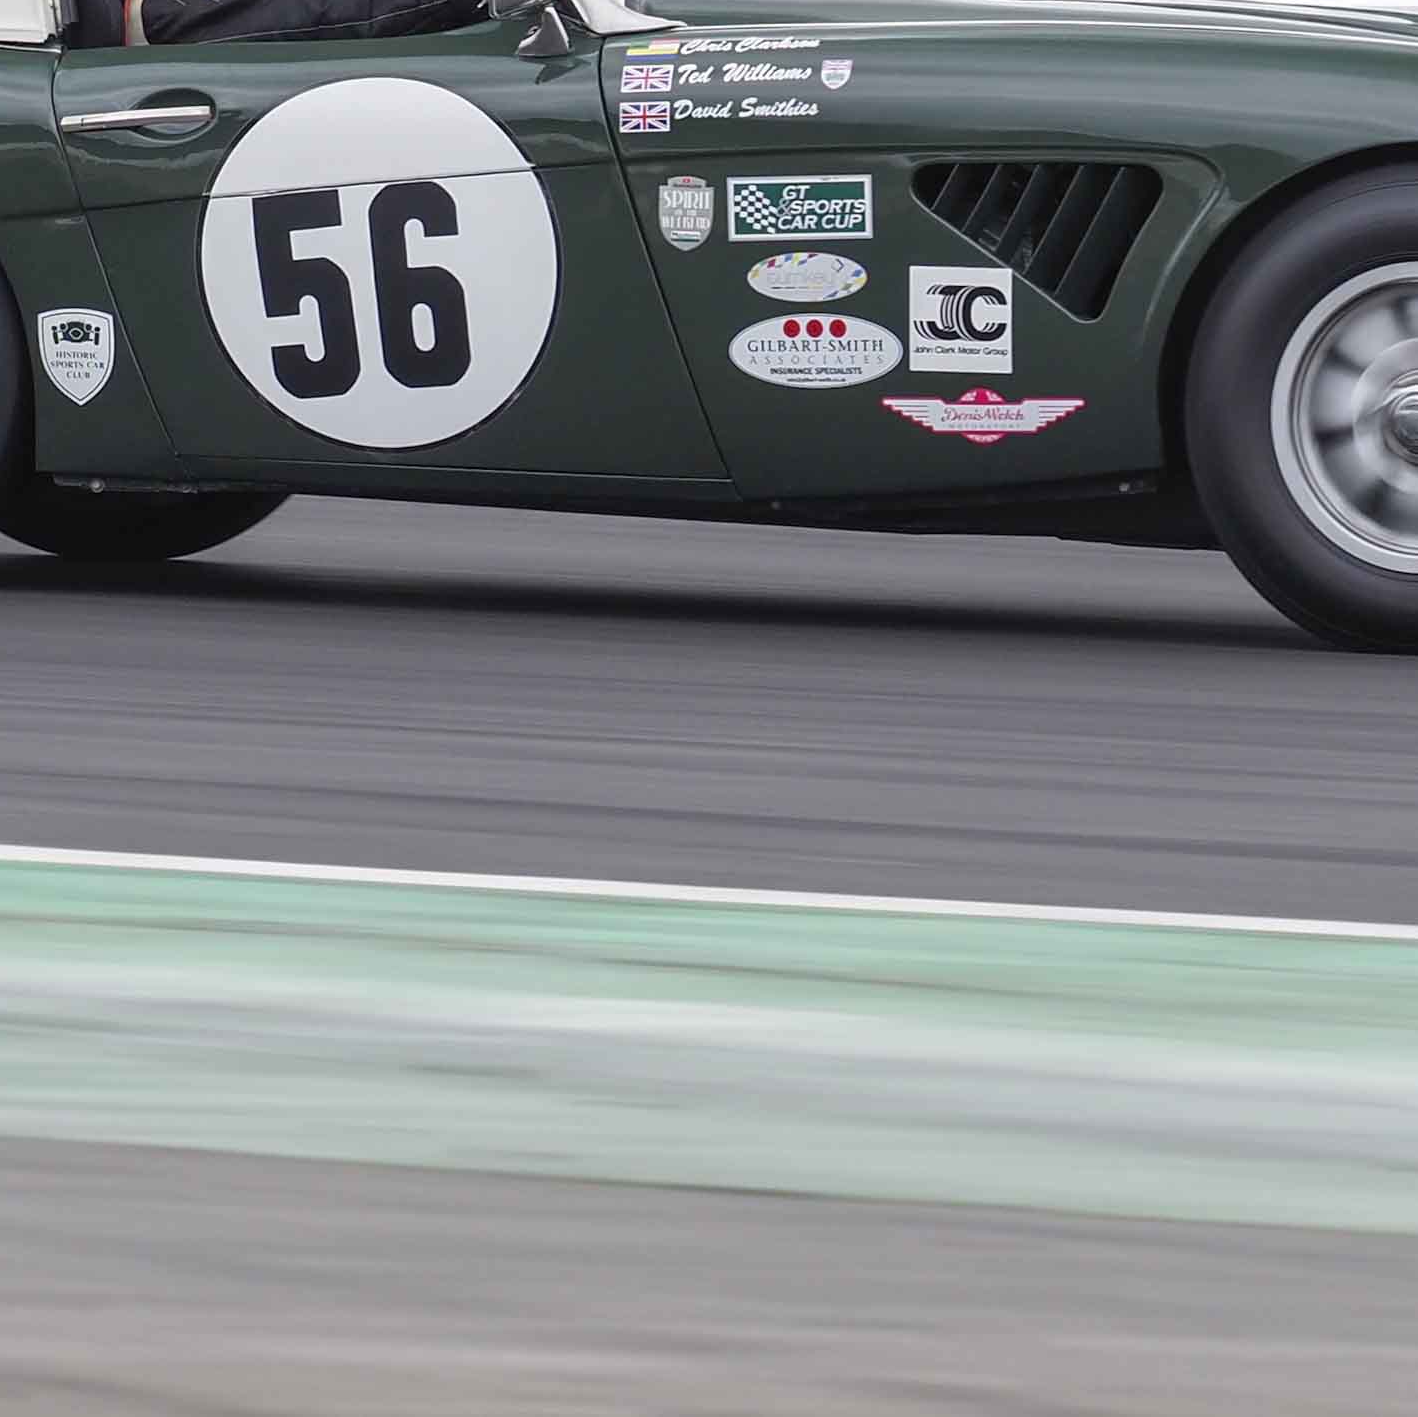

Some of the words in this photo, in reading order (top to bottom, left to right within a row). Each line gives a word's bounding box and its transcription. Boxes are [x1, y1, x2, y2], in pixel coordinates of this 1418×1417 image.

[680, 39, 732, 55] Chris
[677, 63, 714, 85] Ted
[721, 62, 812, 83] Williams
[673, 98, 733, 120] David
[738, 97, 819, 118] Smithies
[662, 189, 710, 210] SPIRIT
[782, 185, 810, 200] GT
[777, 215, 818, 230] CAR
[821, 214, 863, 229] CUP
[251, 181, 472, 399] 56
[746, 339, 884, 353] GILBART-SMITH
[56, 351, 96, 359] HISTORIC
[750, 355, 884, 365] ASSOCIATES
[50, 361, 84, 369] SPORTS
[770, 367, 813, 375] INSURANCE
[815, 367, 862, 375] SPECIALISTS
[66, 371, 90, 379] CLUB
